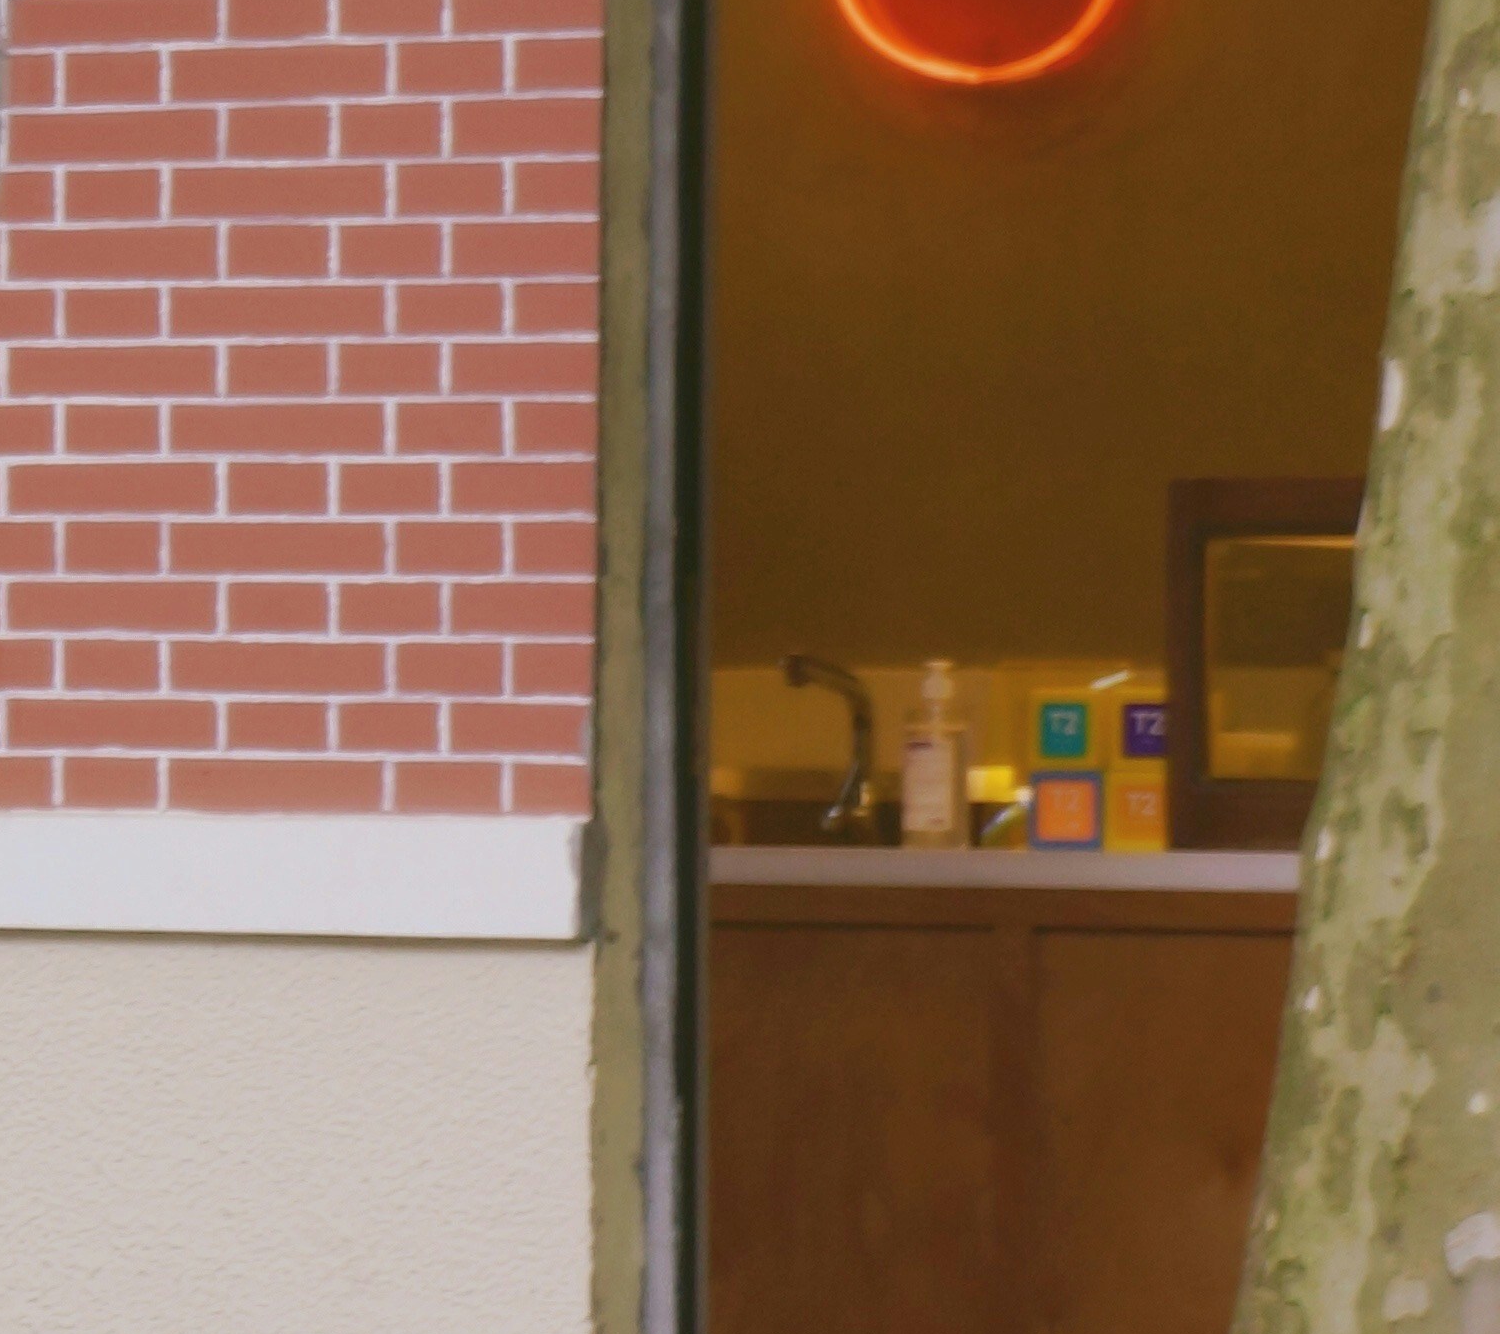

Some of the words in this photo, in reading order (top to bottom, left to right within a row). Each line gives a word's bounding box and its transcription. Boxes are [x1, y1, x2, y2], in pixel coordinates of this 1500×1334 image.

[1051, 710, 1079, 736] T2
[1133, 710, 1166, 737] T2
[1127, 791, 1157, 816] T2
